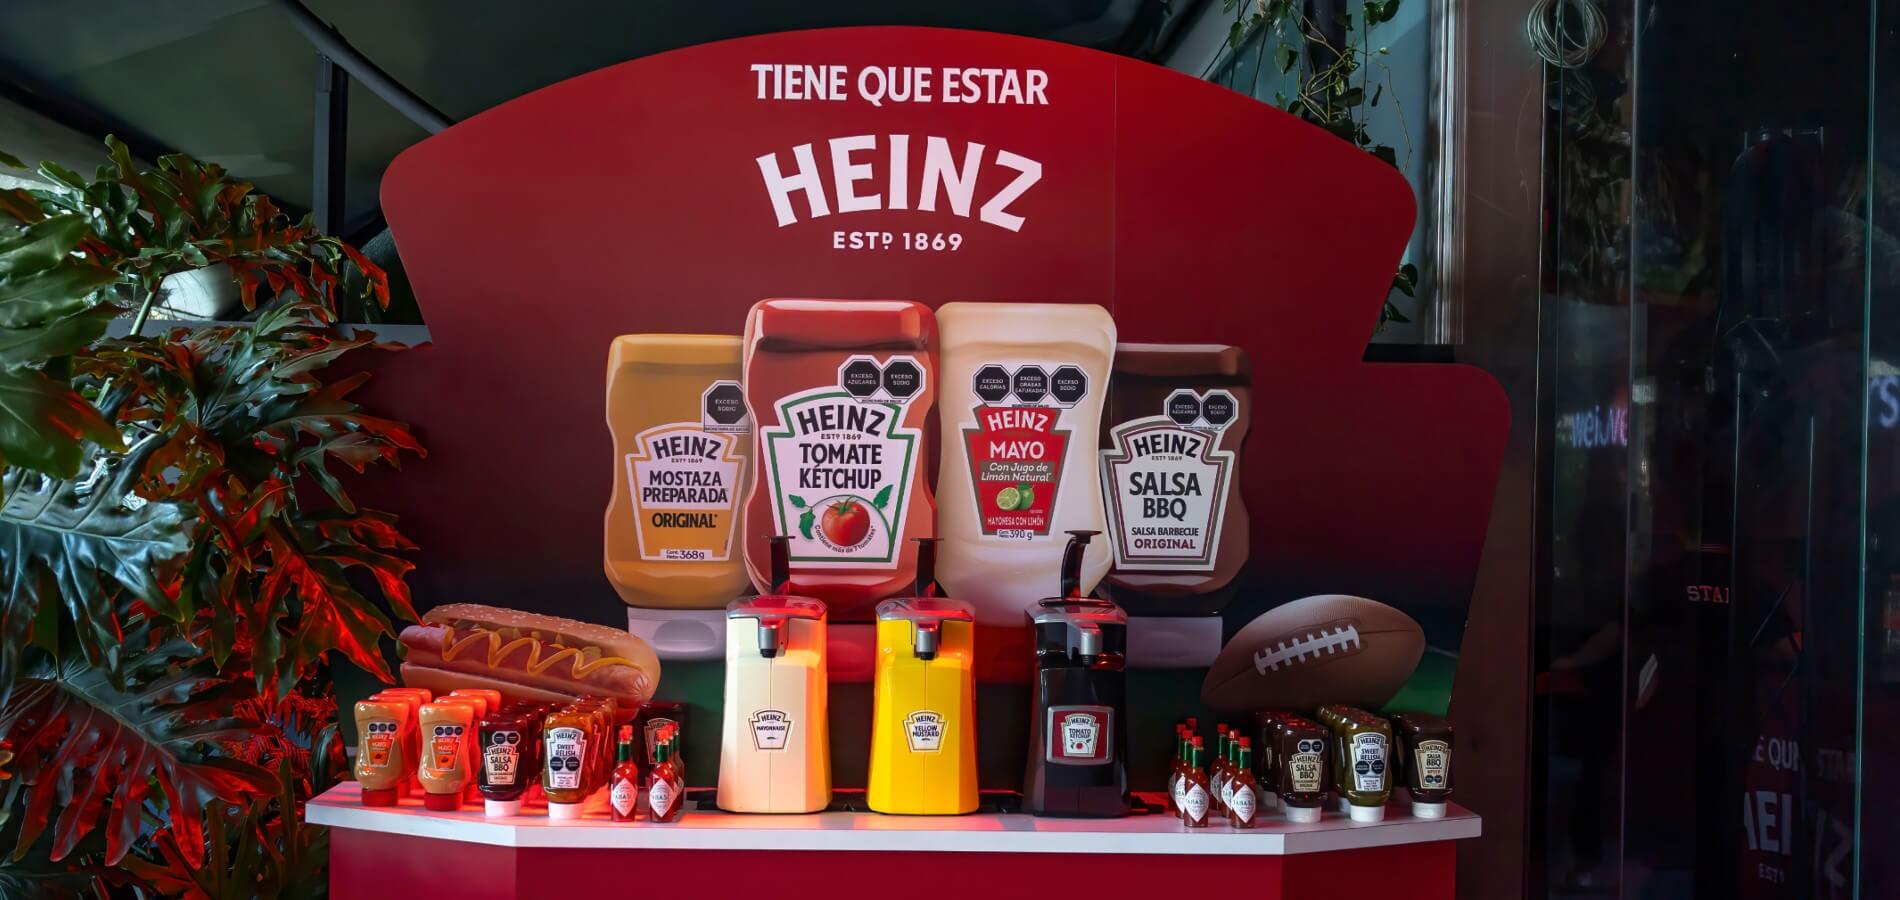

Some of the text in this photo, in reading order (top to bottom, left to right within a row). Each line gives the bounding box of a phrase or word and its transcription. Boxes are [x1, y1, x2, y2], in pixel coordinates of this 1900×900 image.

[751, 64, 1049, 107] TIENE QUE ESTAR
[755, 134, 1042, 232] HEINZ
[903, 233, 962, 251] 1869
[796, 405, 886, 437] HEINZ
[987, 410, 1049, 433] HEINZ
[652, 435, 722, 460] HEINZ
[989, 441, 1044, 459] MAYO
[1133, 433, 1201, 458] HEINZ
[799, 443, 882, 465] TOMATE
[800, 465, 881, 489] KÉTCHUP
[981, 472, 1010, 481] Limón
[990, 462, 1048, 476] Con Jugo de
[649, 470, 722, 486] MOSTAZA
[1129, 472, 1202, 496] SALSA
[642, 487, 728, 503] PREPARADA
[1143, 498, 1187, 521] BBQ
[988, 515, 1044, 526] MAYONESA CON LIMÓN
[815, 525, 832, 548] Contiene
[1009, 530, 1025, 538] 390
[1027, 531, 1033, 540] g
[1132, 527, 1199, 536] SALSA BARBECUE
[1134, 539, 1196, 549] ORIGINAL
[761, 714, 781, 722] HEINZ
[915, 715, 936, 723] HEINZ
[1070, 717, 1090, 725] HEINZ
[556, 732, 577, 740] HEINZ
[491, 747, 511, 755] HEINZ
[490, 756, 512, 764] SALSA
[1426, 759, 1441, 767] BBQ
